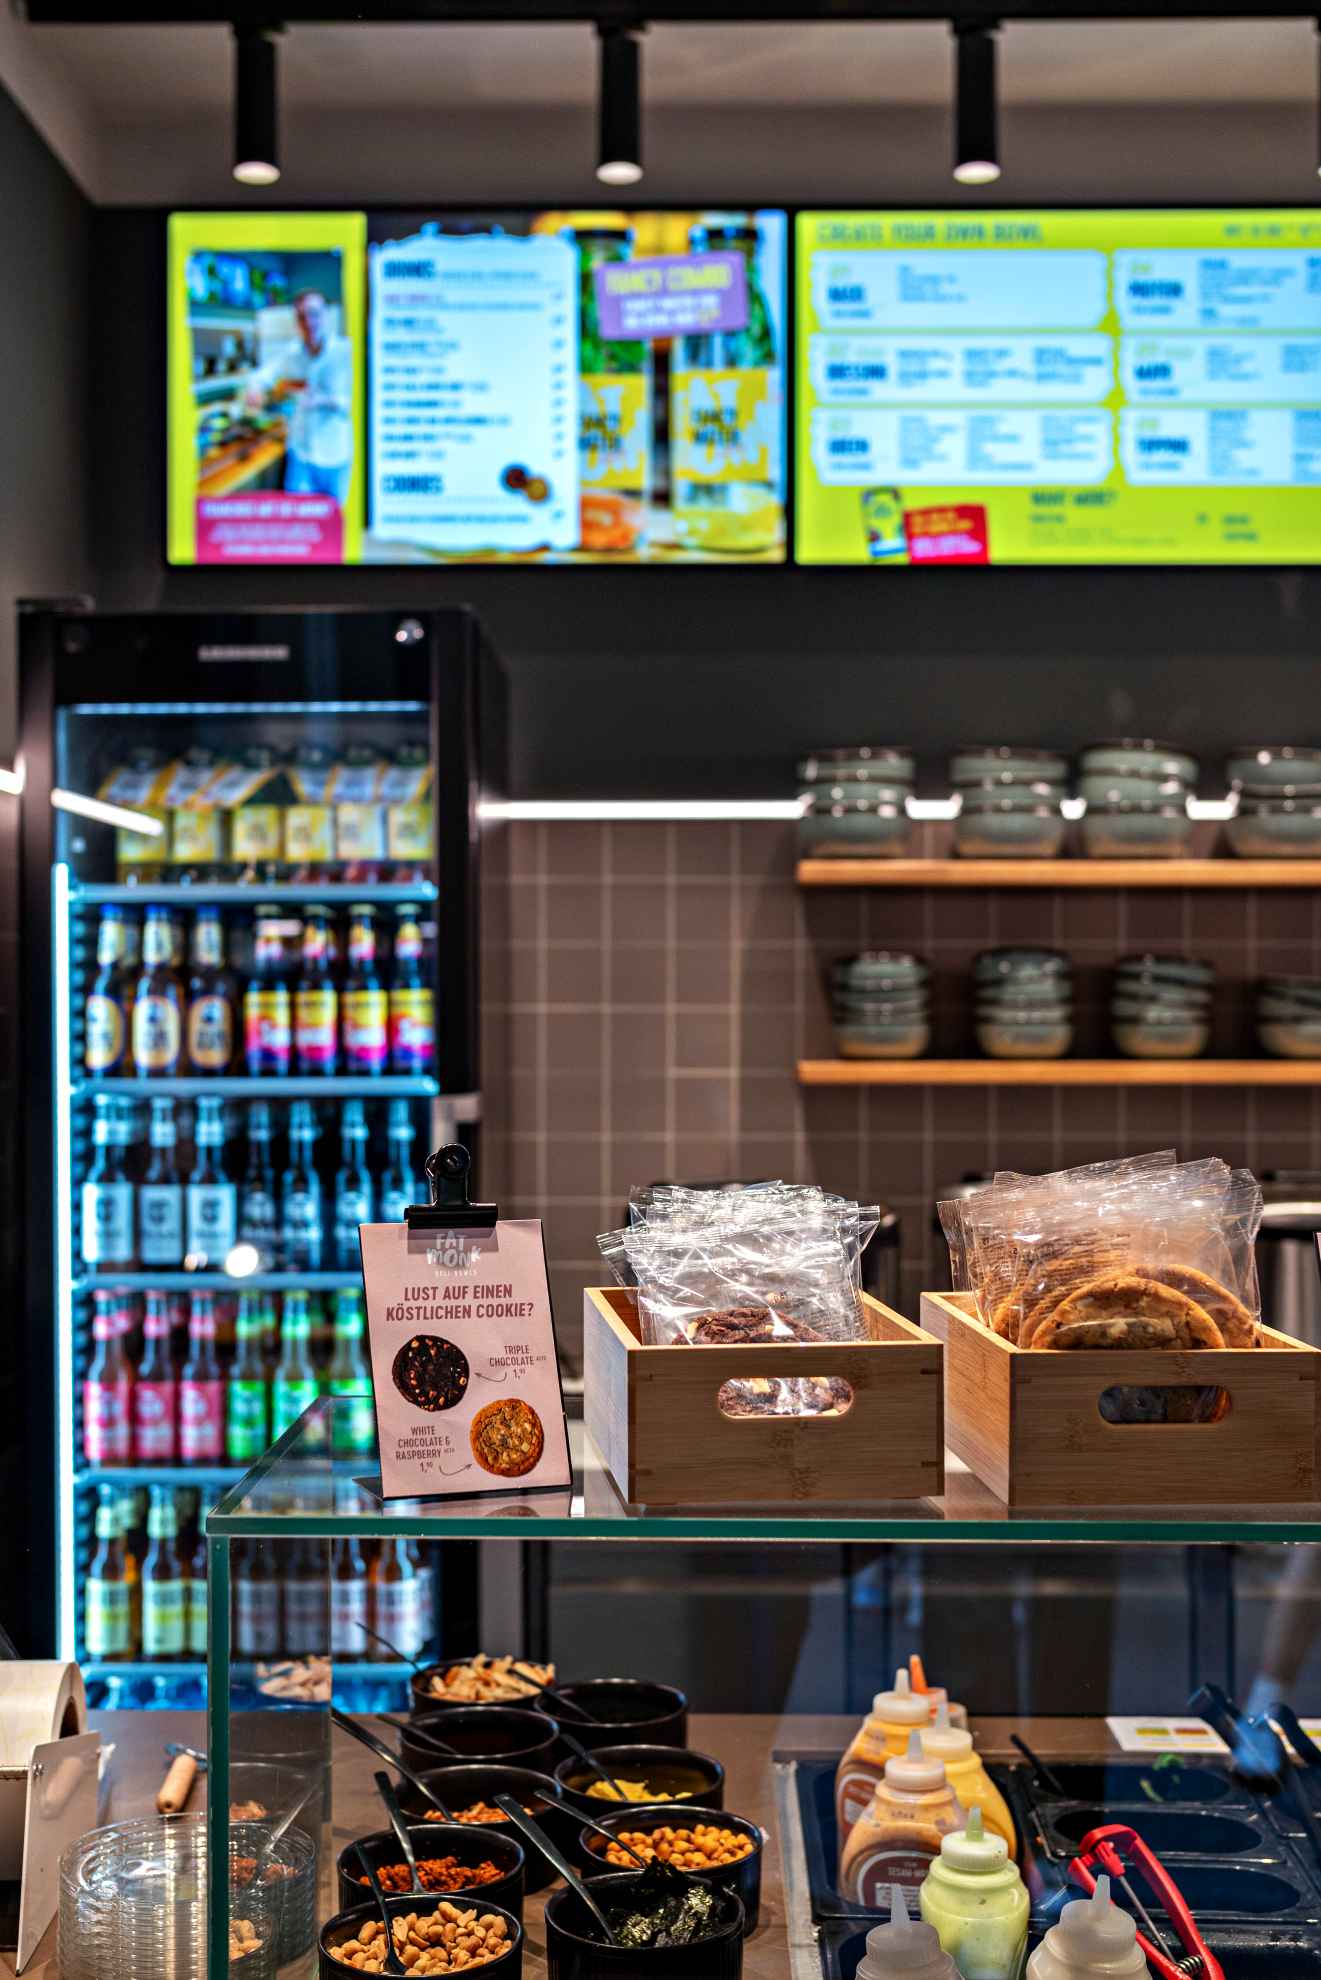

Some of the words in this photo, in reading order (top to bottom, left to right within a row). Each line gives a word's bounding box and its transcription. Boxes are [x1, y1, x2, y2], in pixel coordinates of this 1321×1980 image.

[436, 1230, 468, 1250] FAT
[426, 1245, 481, 1268] MONK
[404, 1286, 438, 1302] LUST
[442, 1285, 469, 1301] AUF
[473, 1283, 512, 1300] EINEN
[386, 1303, 472, 1322] KÖSTLICHEN
[476, 1302, 534, 1319] COOKIE?
[504, 1344, 530, 1355] TRIPLE
[489, 1355, 534, 1368] CHOCOLATE
[410, 1425, 435, 1436] WHITE
[398, 1436, 442, 1449] CHOCOLATE
[395, 1448, 441, 1461] RASPBERRY
